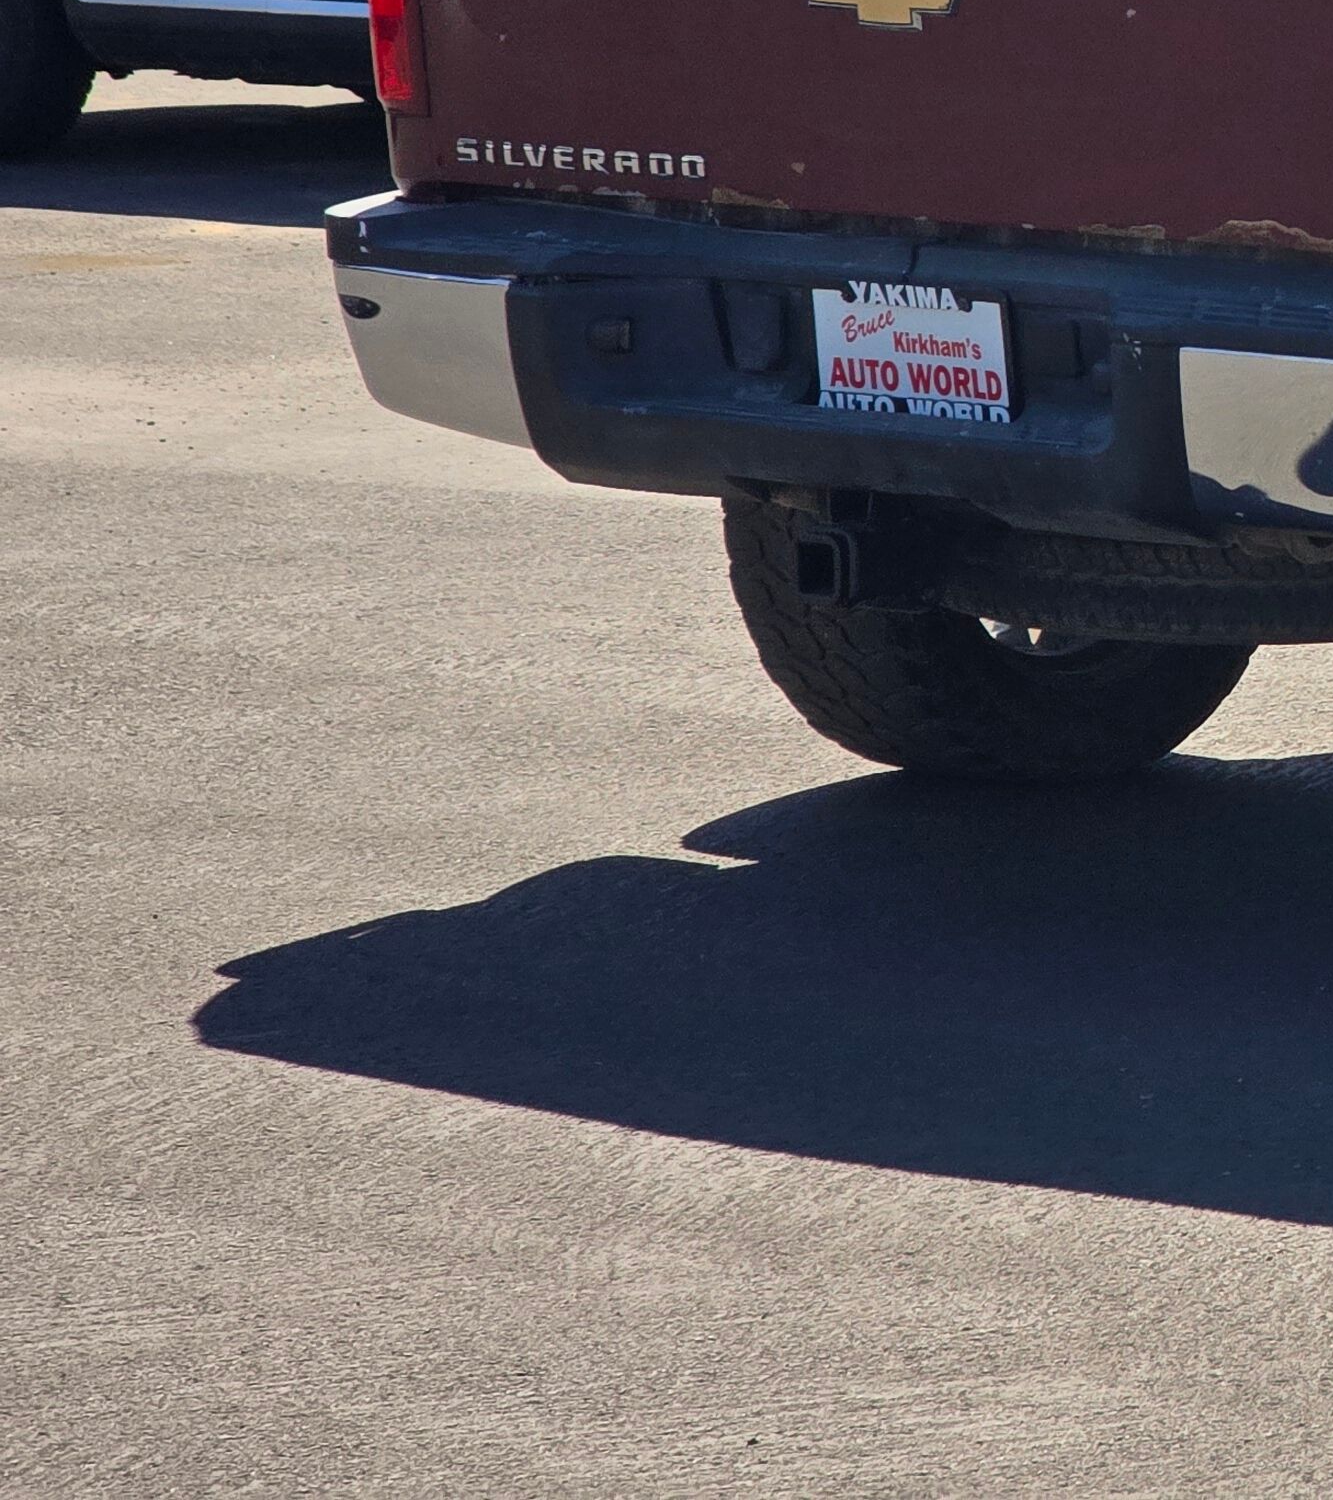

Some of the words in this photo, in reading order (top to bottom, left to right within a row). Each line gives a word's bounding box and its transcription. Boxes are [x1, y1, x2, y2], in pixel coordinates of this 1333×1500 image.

[456, 138, 706, 179] SILVERADO
[848, 280, 960, 311] YAKIMA
[842, 310, 896, 342] Bruce
[892, 331, 982, 360] Kirkham's
[830, 357, 899, 391] AUTO
[906, 362, 1003, 400] WORLD
